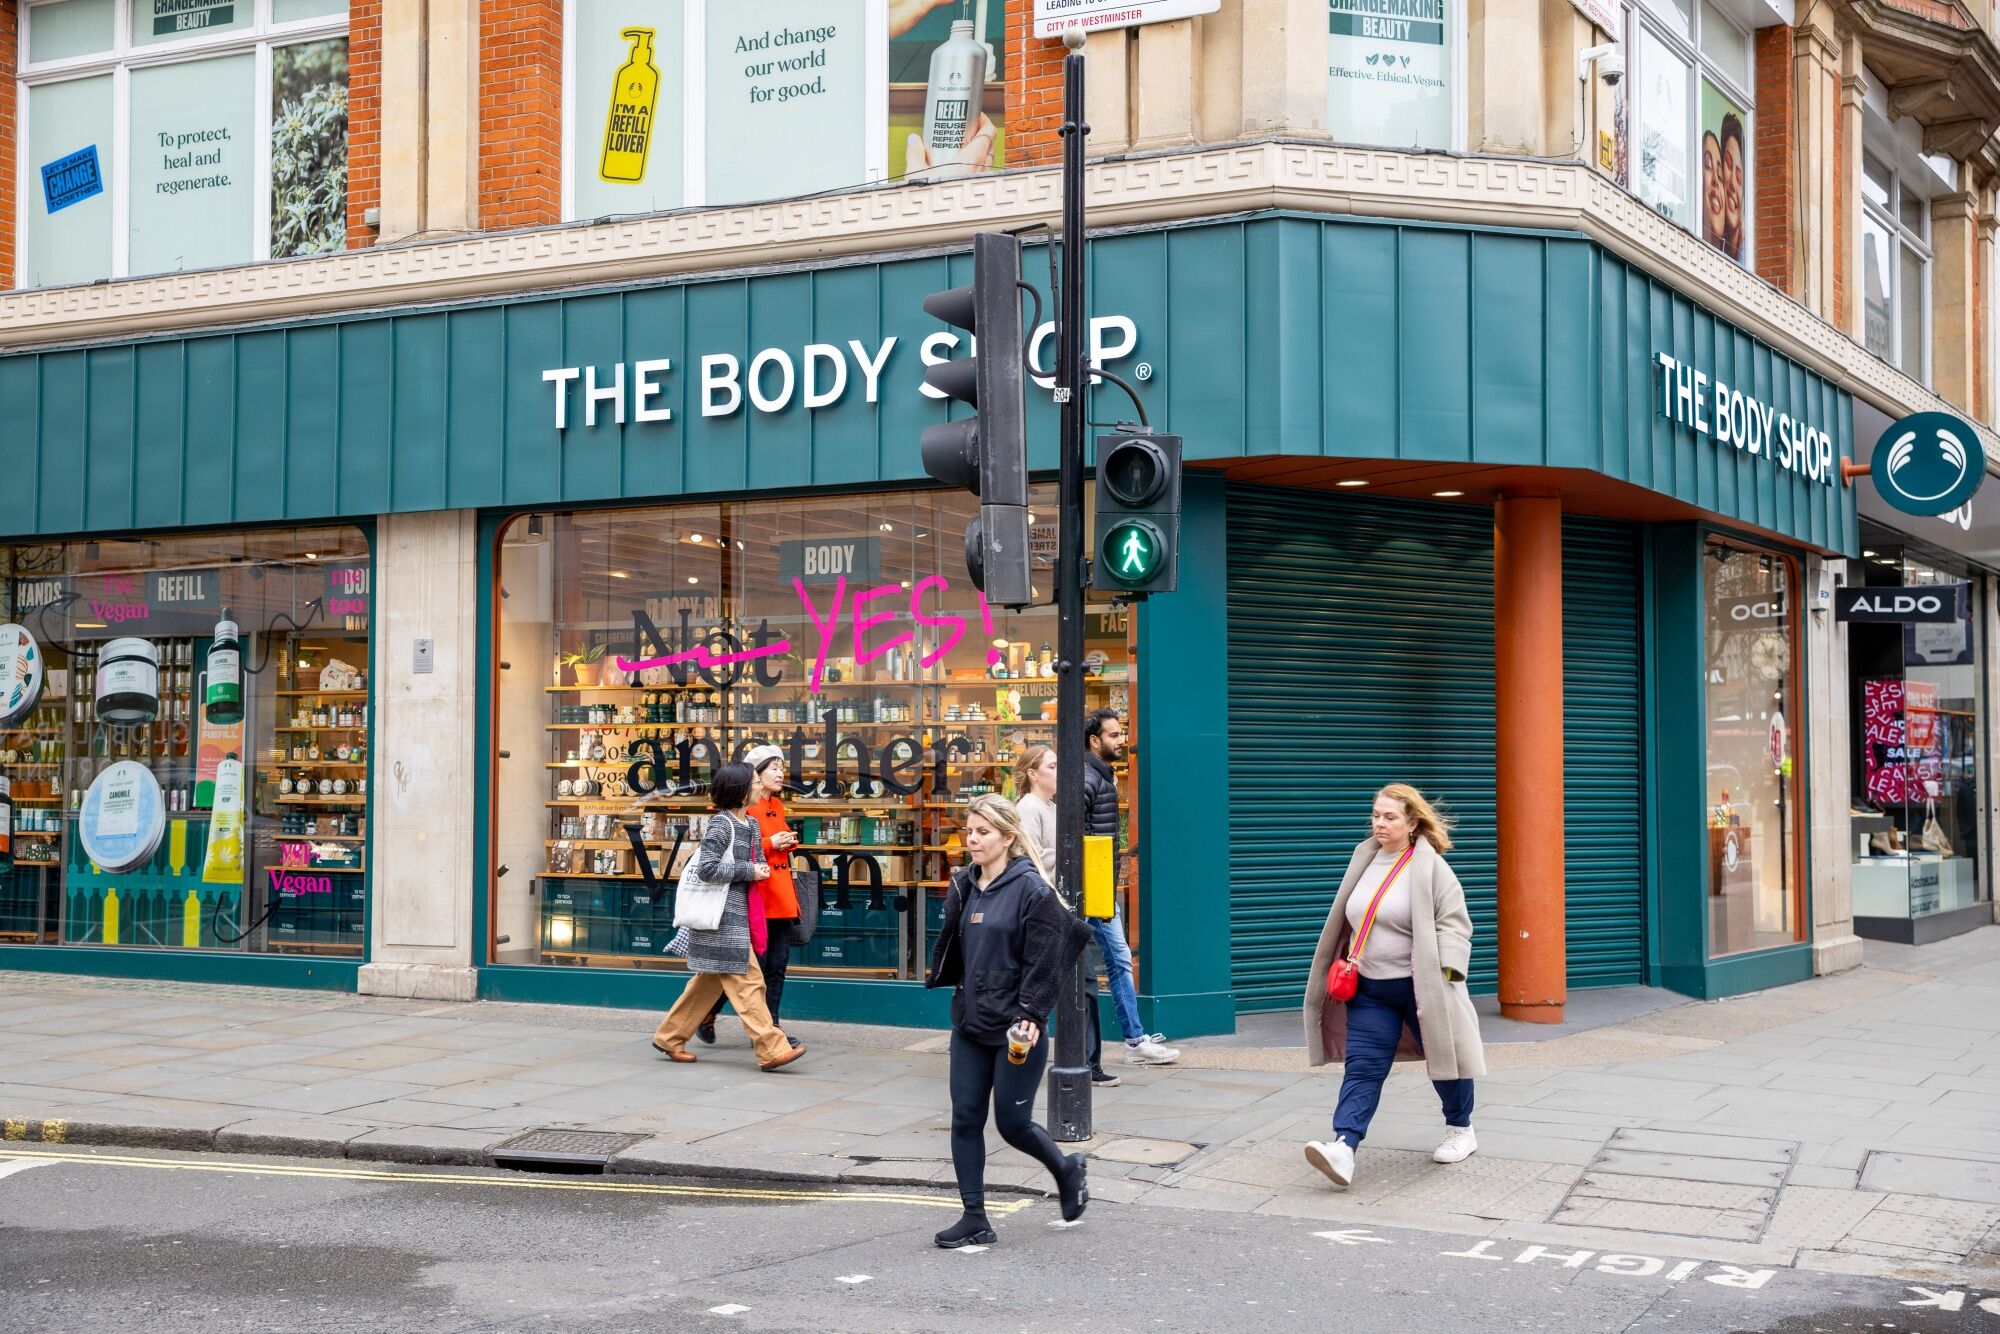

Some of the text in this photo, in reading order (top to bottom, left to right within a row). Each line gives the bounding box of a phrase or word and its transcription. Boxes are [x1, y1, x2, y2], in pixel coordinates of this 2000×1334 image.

[176, 10, 211, 31] BEAUTY
[1047, 20, 1065, 32] CITY
[1081, 10, 1142, 27] WESTMINSTER
[1362, 17, 1411, 40] BEAUTY
[734, 25, 836, 54] And change
[744, 51, 826, 78] our world
[1329, 66, 1445, 88] Effective. Ethical. Vegan.
[750, 76, 826, 104] for good.
[615, 104, 648, 115] I'M A
[936, 101, 967, 119] REFILL
[611, 114, 646, 134] REFILL
[158, 126, 231, 149] To protect,
[608, 133, 645, 154] LOVER
[69, 150, 94, 165] MAKE
[164, 149, 221, 170] heal and
[48, 159, 96, 198] CHANGE
[156, 173, 232, 194] regenerate.
[51, 183, 100, 208] TOGETHER
[542, 358, 672, 430] THE
[700, 336, 899, 418] BODY
[918, 315, 1138, 400] SOP
[1660, 351, 1832, 484] THE BODY SHOP
[804, 545, 855, 576] BODY
[17, 581, 62, 607] HANDS
[158, 575, 206, 602] REFILL
[90, 599, 149, 623] Vegan
[329, 596, 365, 616] too
[1850, 595, 1941, 614] ALDO
[792, 575, 1001, 694] YES!
[631, 608, 783, 691] Not
[1887, 747, 1921, 758] SALE
[109, 789, 131, 799] CAMOMILE
[268, 868, 332, 896] Vegan
[1438, 1240, 1778, 1290] RIGHT
